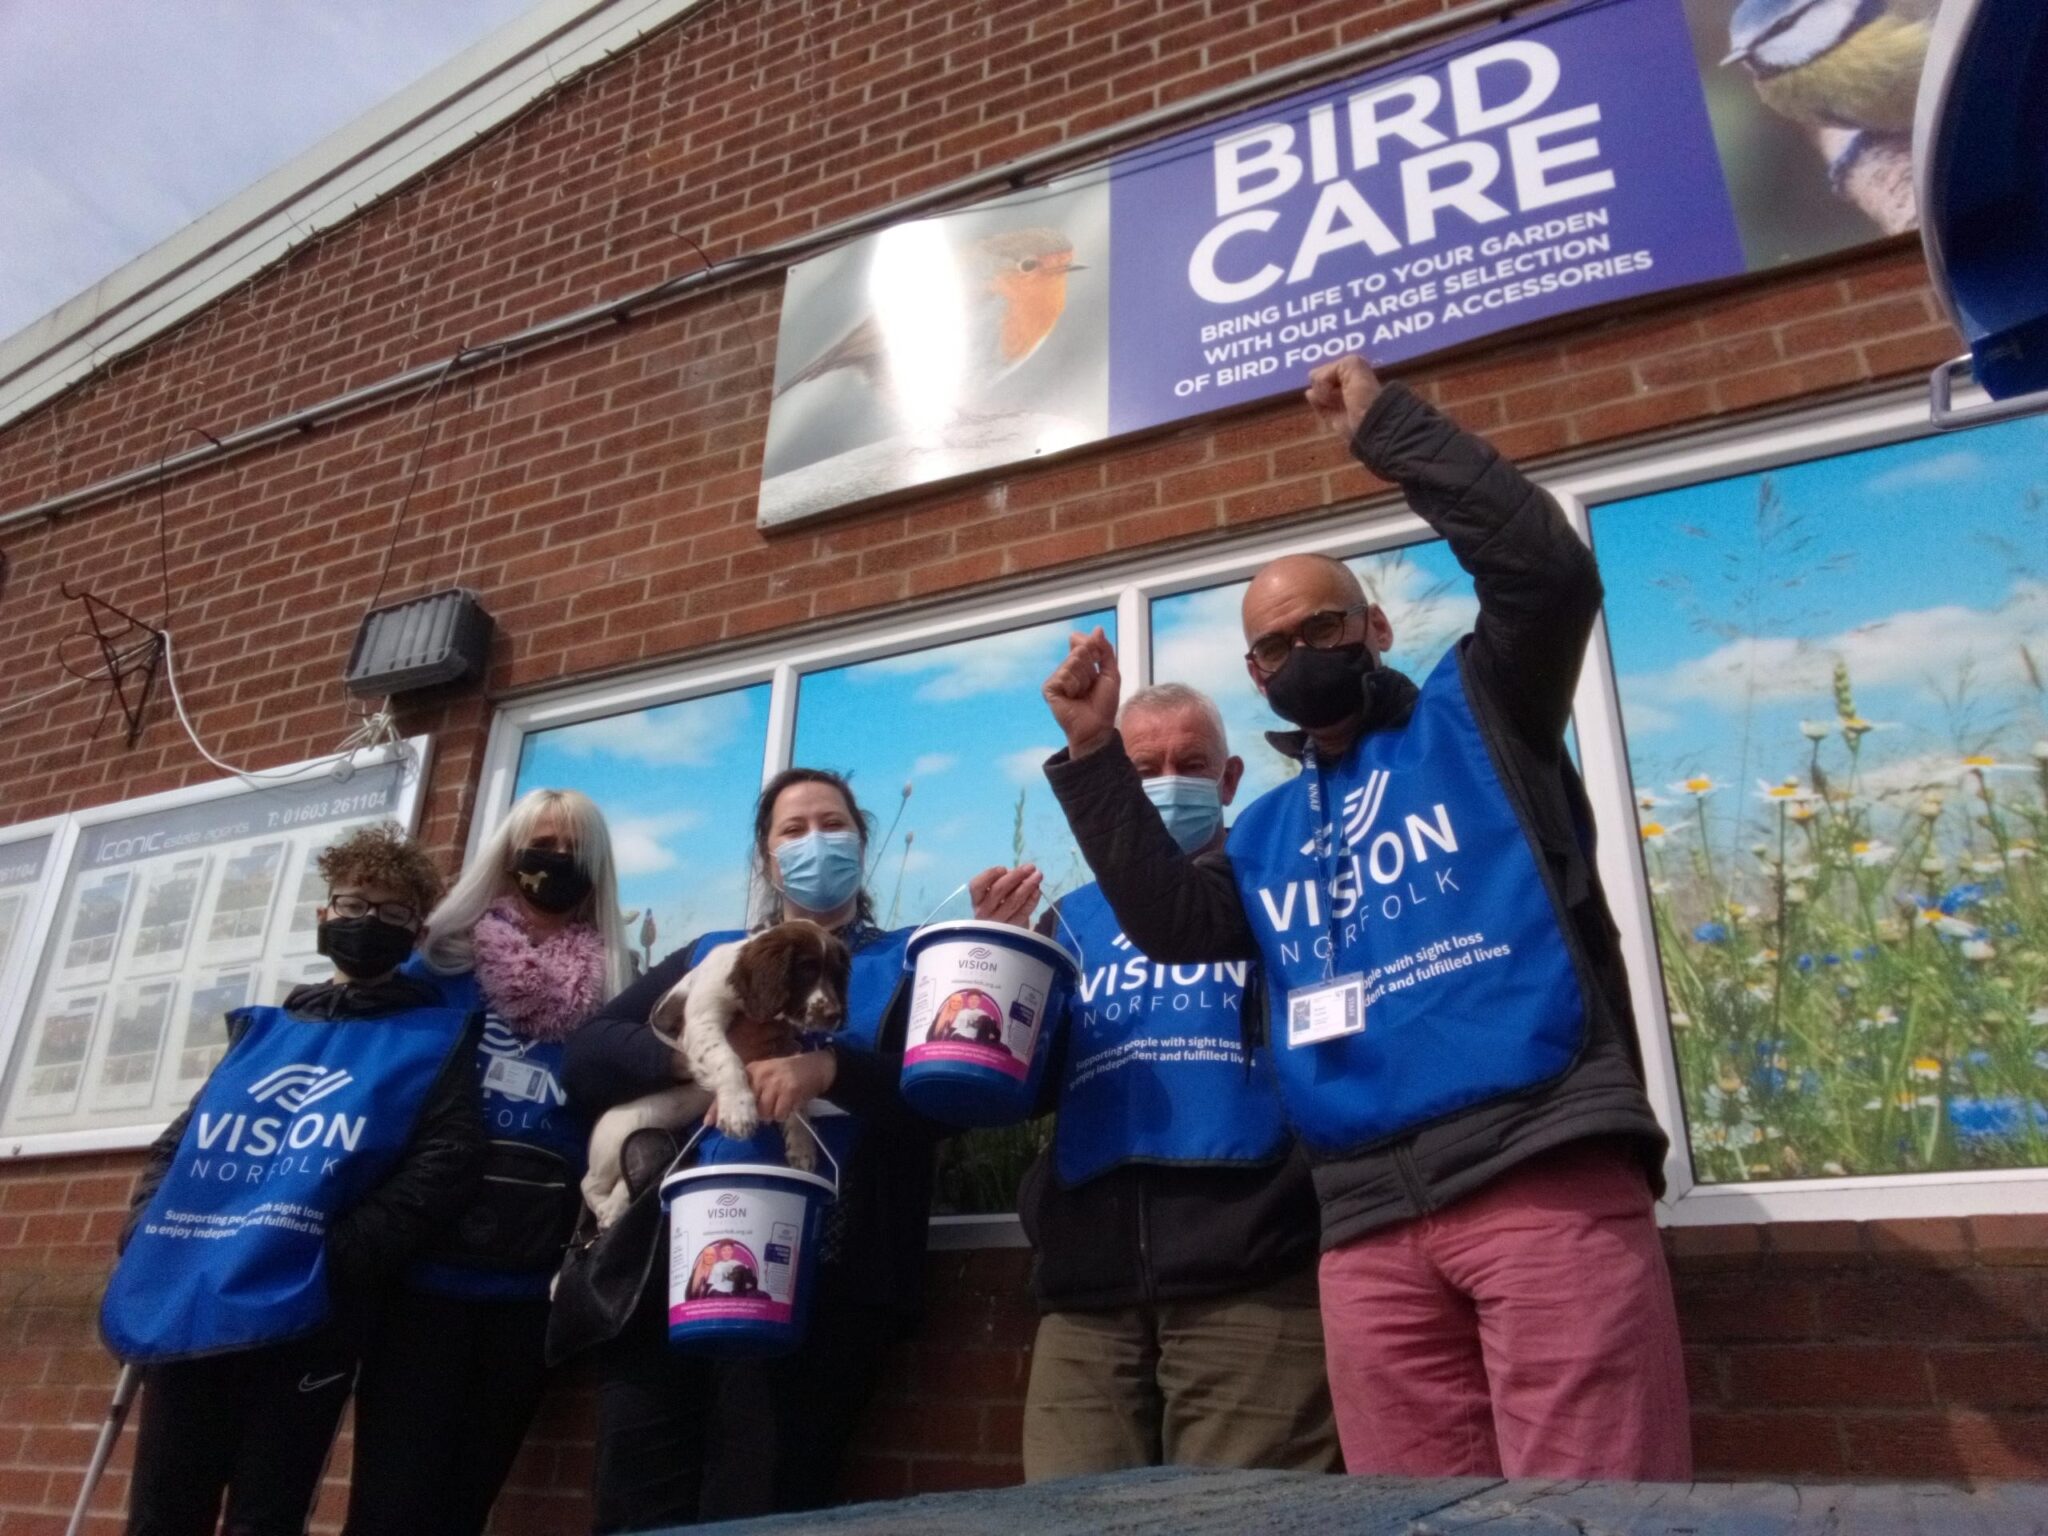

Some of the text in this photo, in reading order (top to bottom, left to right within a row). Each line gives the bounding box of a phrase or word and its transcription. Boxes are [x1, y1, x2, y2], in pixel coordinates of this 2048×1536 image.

[1214, 39, 1560, 218] BIRD
[1188, 103, 1615, 304] CARE
[1201, 207, 1609, 344] BRING LIFE TO YOUR GARDEN
[1203, 233, 1611, 365] WITH OUR LARGE SELECTION
[1174, 249, 1654, 397] OF BIRD FOOD AND ACCESSORIES
[283, 804, 328, 825] 01603
[331, 791, 387, 814] 261104
[1258, 803, 1459, 932] VISION
[1281, 867, 1460, 966] NORFOLK
[959, 960, 998, 972] VISION
[1080, 955, 1246, 1003] VISION
[1364, 932, 1484, 990] ople with sight loss
[1388, 944, 1511, 993] and fulfilled lives
[1084, 991, 1238, 1029] NORFOLK
[1124, 1037, 1158, 1052] people
[1160, 1036, 1186, 1047] with
[1188, 1036, 1217, 1049] sight
[1219, 1038, 1242, 1050] loss
[1159, 1050, 1181, 1062] and
[1183, 1050, 1228, 1062] fulfilled
[197, 1113, 367, 1156] VISION
[190, 1157, 340, 1184] NORFOLK
[145, 1224, 157, 1234] to
[159, 1225, 191, 1239] enjoy
[264, 1215, 309, 1232] fulfilled
[165, 1209, 227, 1226] Supporting
[273, 1202, 302, 1215] sight
[303, 1205, 325, 1220] loss
[706, 1207, 747, 1219] VISION
